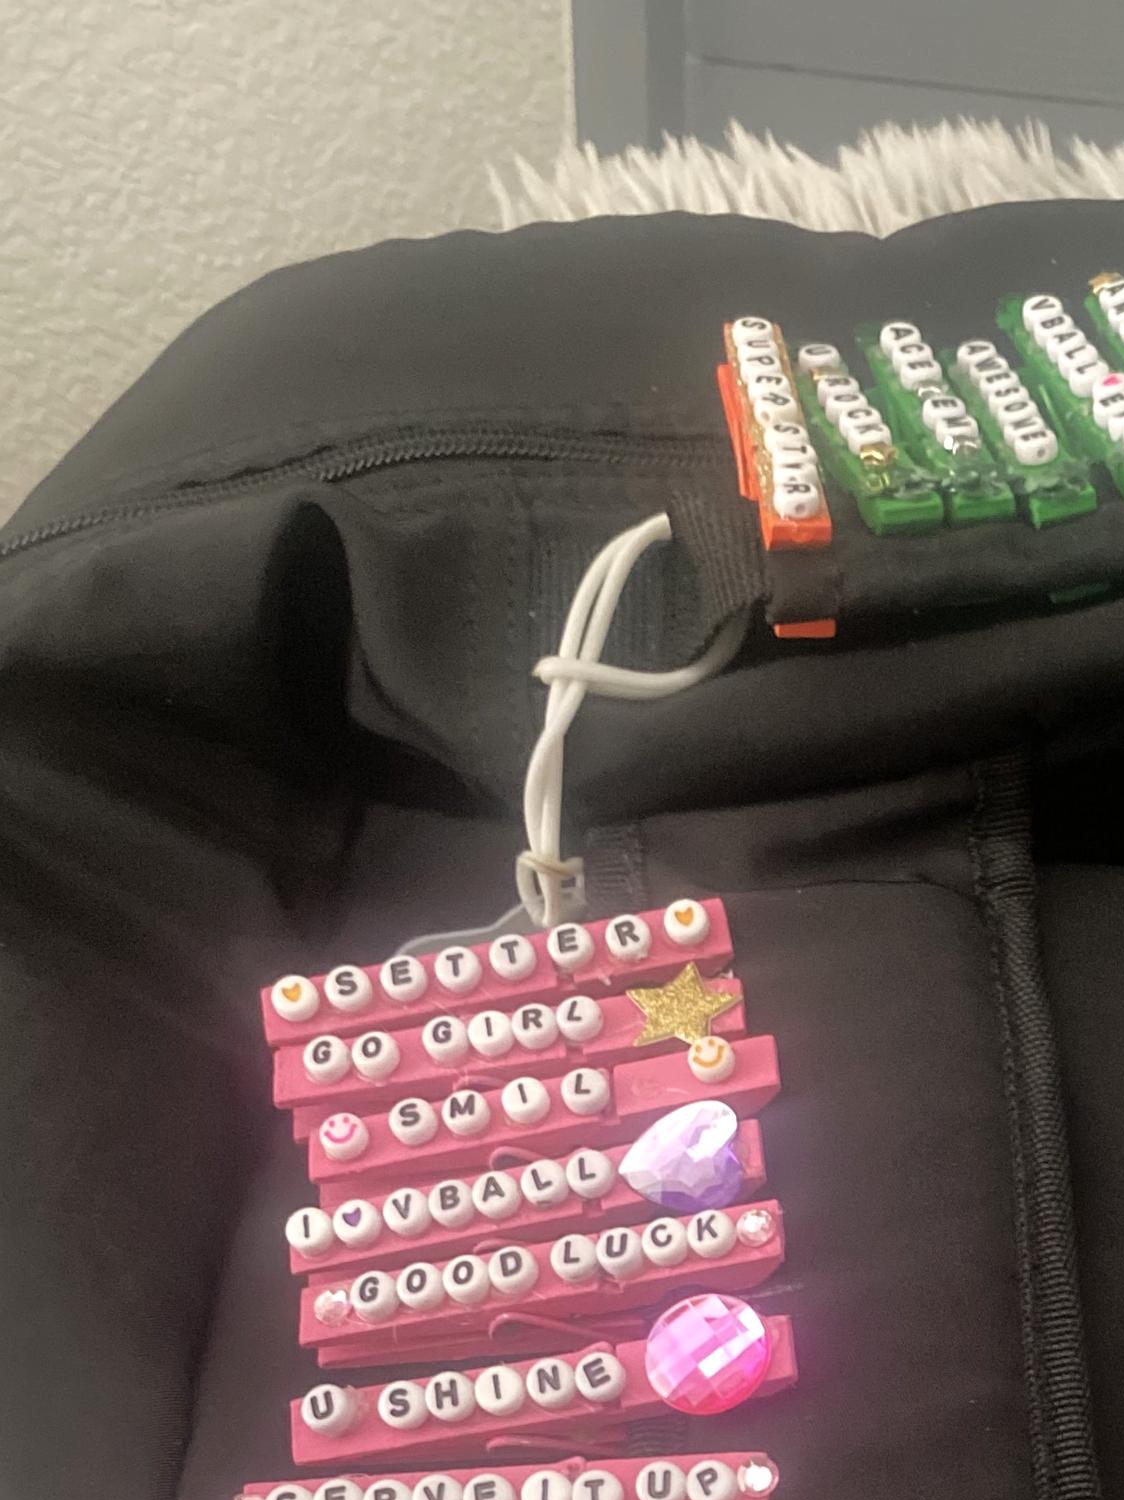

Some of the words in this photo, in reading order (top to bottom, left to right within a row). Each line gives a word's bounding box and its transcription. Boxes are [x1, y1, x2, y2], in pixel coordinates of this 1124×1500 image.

[741, 319, 791, 406] SUPER
[889, 325, 934, 371] ACE
[1029, 297, 1099, 375] VBALL
[824, 377, 884, 435] ROCK
[967, 345, 1048, 442] AWESOME
[335, 922, 641, 993] SETTER
[312, 1036, 382, 1063] GO
[431, 1000, 583, 1045] GIRL
[398, 1074, 592, 1126] SMIL
[392, 1158, 597, 1221] VBALL
[358, 1249, 524, 1302] GOOD
[563, 1213, 720, 1265] LUCK
[388, 1358, 612, 1416] SHINE
[647, 1460, 719, 1500] UP
